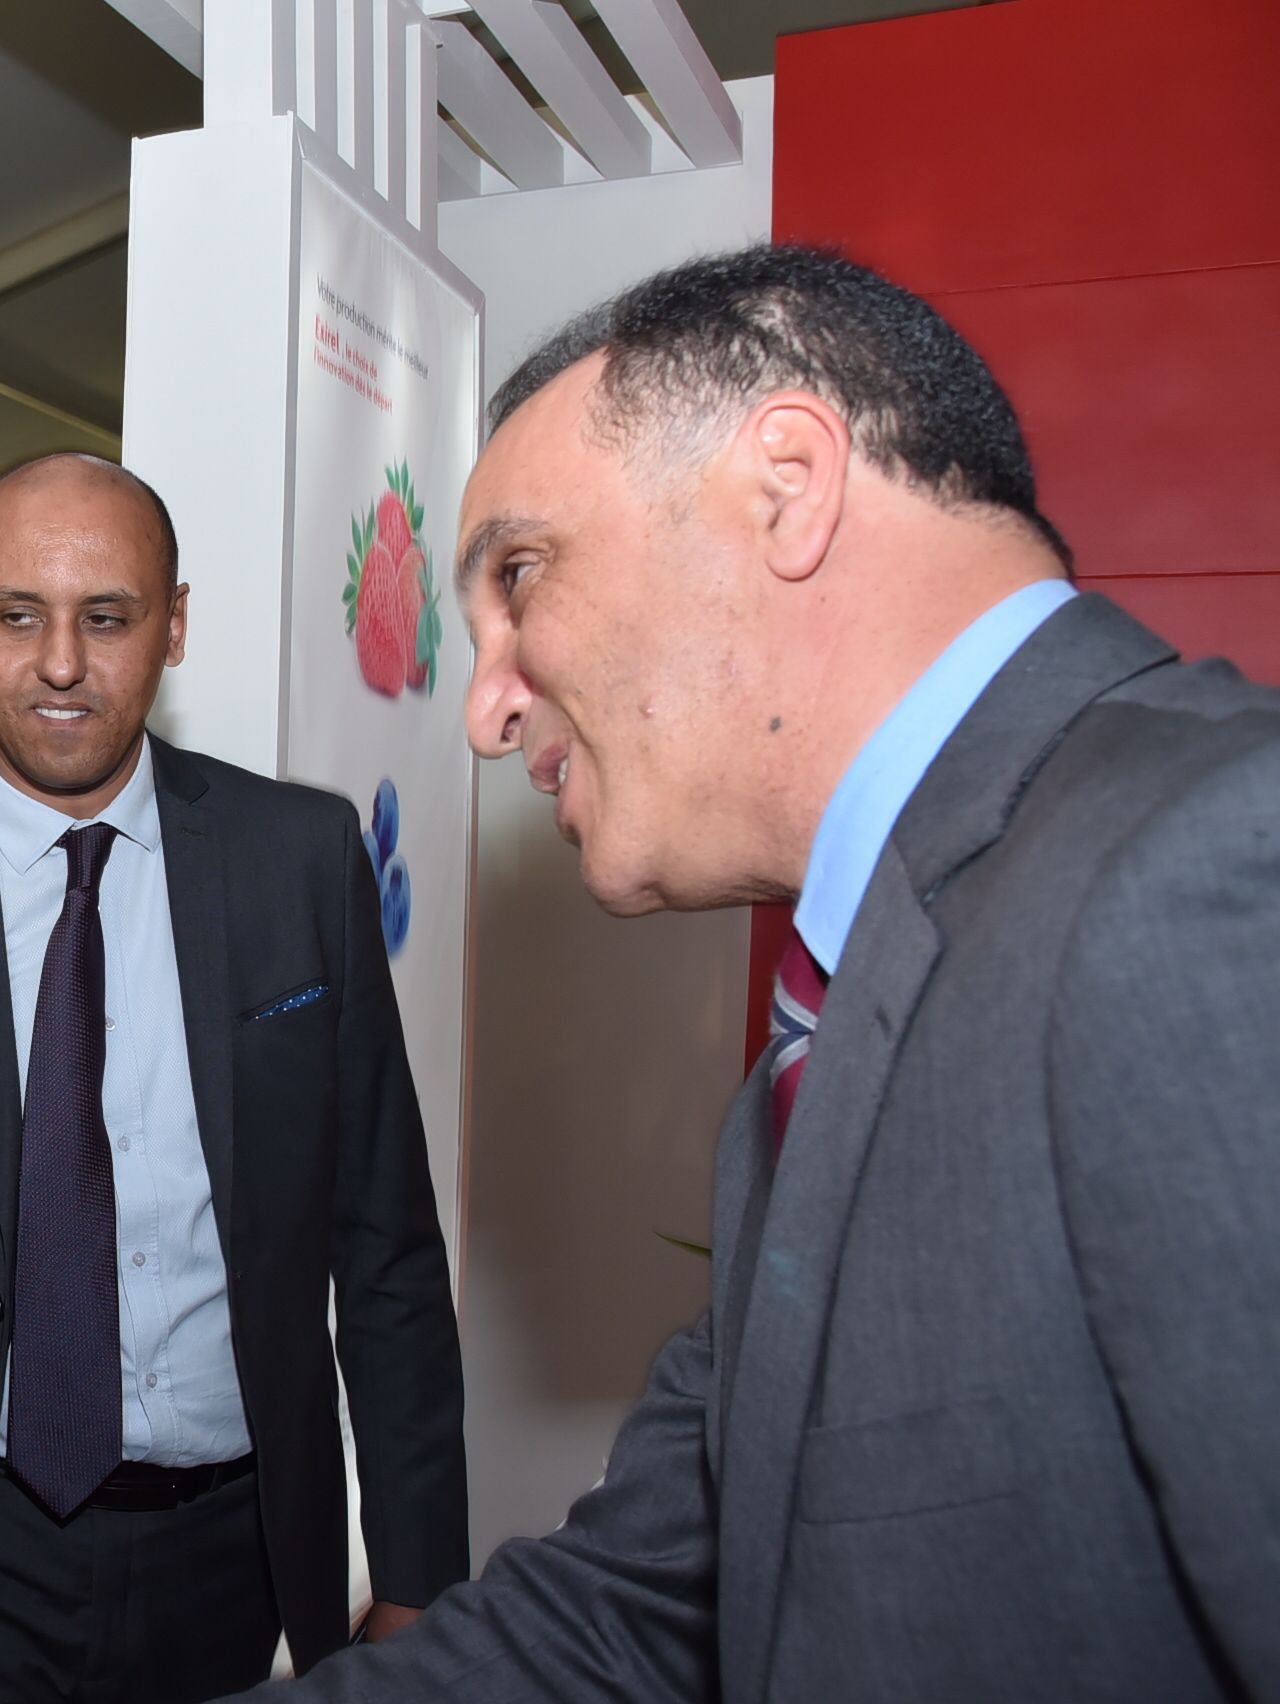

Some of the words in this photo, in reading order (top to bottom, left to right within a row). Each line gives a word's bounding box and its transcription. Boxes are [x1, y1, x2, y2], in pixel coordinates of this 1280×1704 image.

[317, 275, 335, 310] Votre
[336, 298, 375, 339] production
[315, 315, 340, 355] Exirel
[346, 341, 351, 362] le
[352, 348, 369, 375] choix
[370, 361, 378, 381] de
